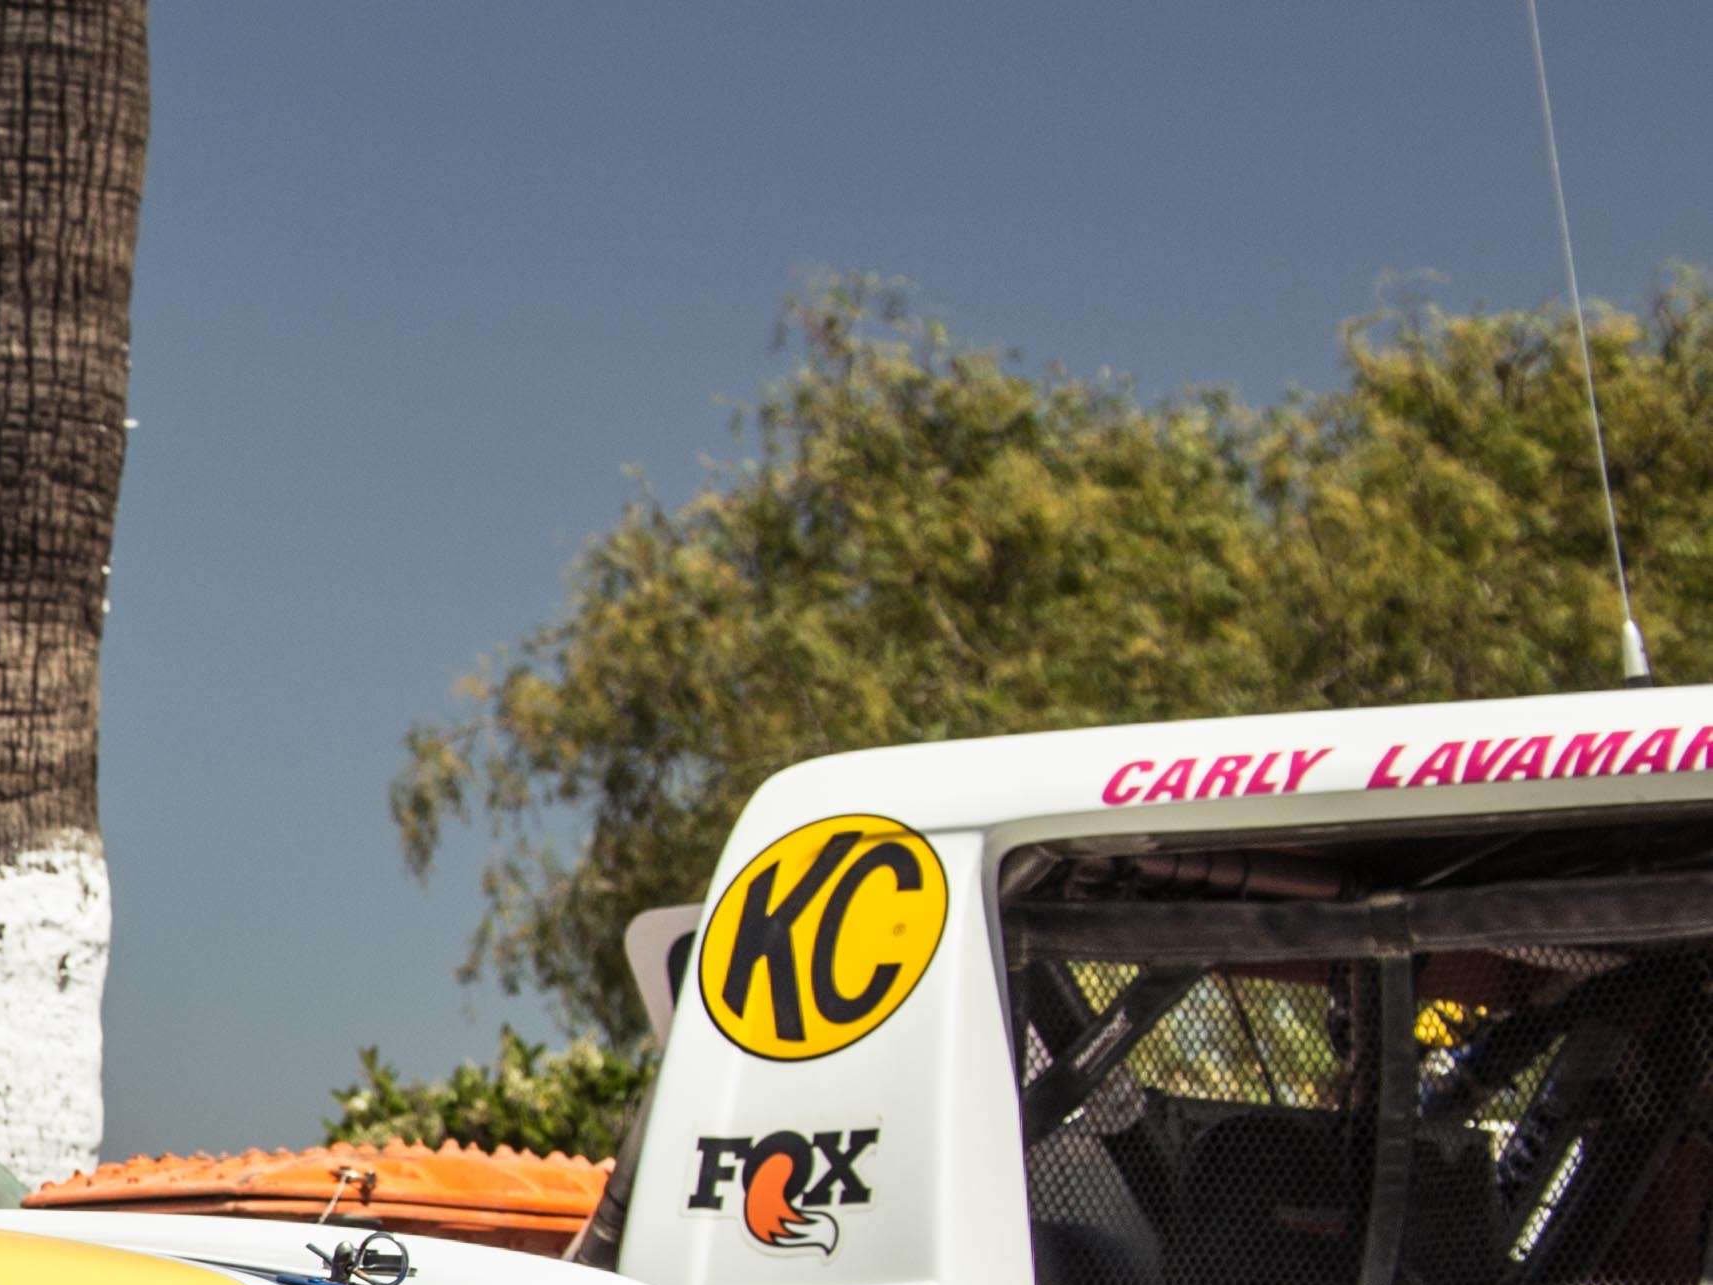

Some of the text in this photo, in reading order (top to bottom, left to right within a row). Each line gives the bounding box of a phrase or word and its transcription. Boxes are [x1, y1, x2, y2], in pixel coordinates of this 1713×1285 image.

[1100, 746, 1336, 806] CARLY
[722, 830, 925, 1043] KC
[688, 1128, 880, 1215] FOX
